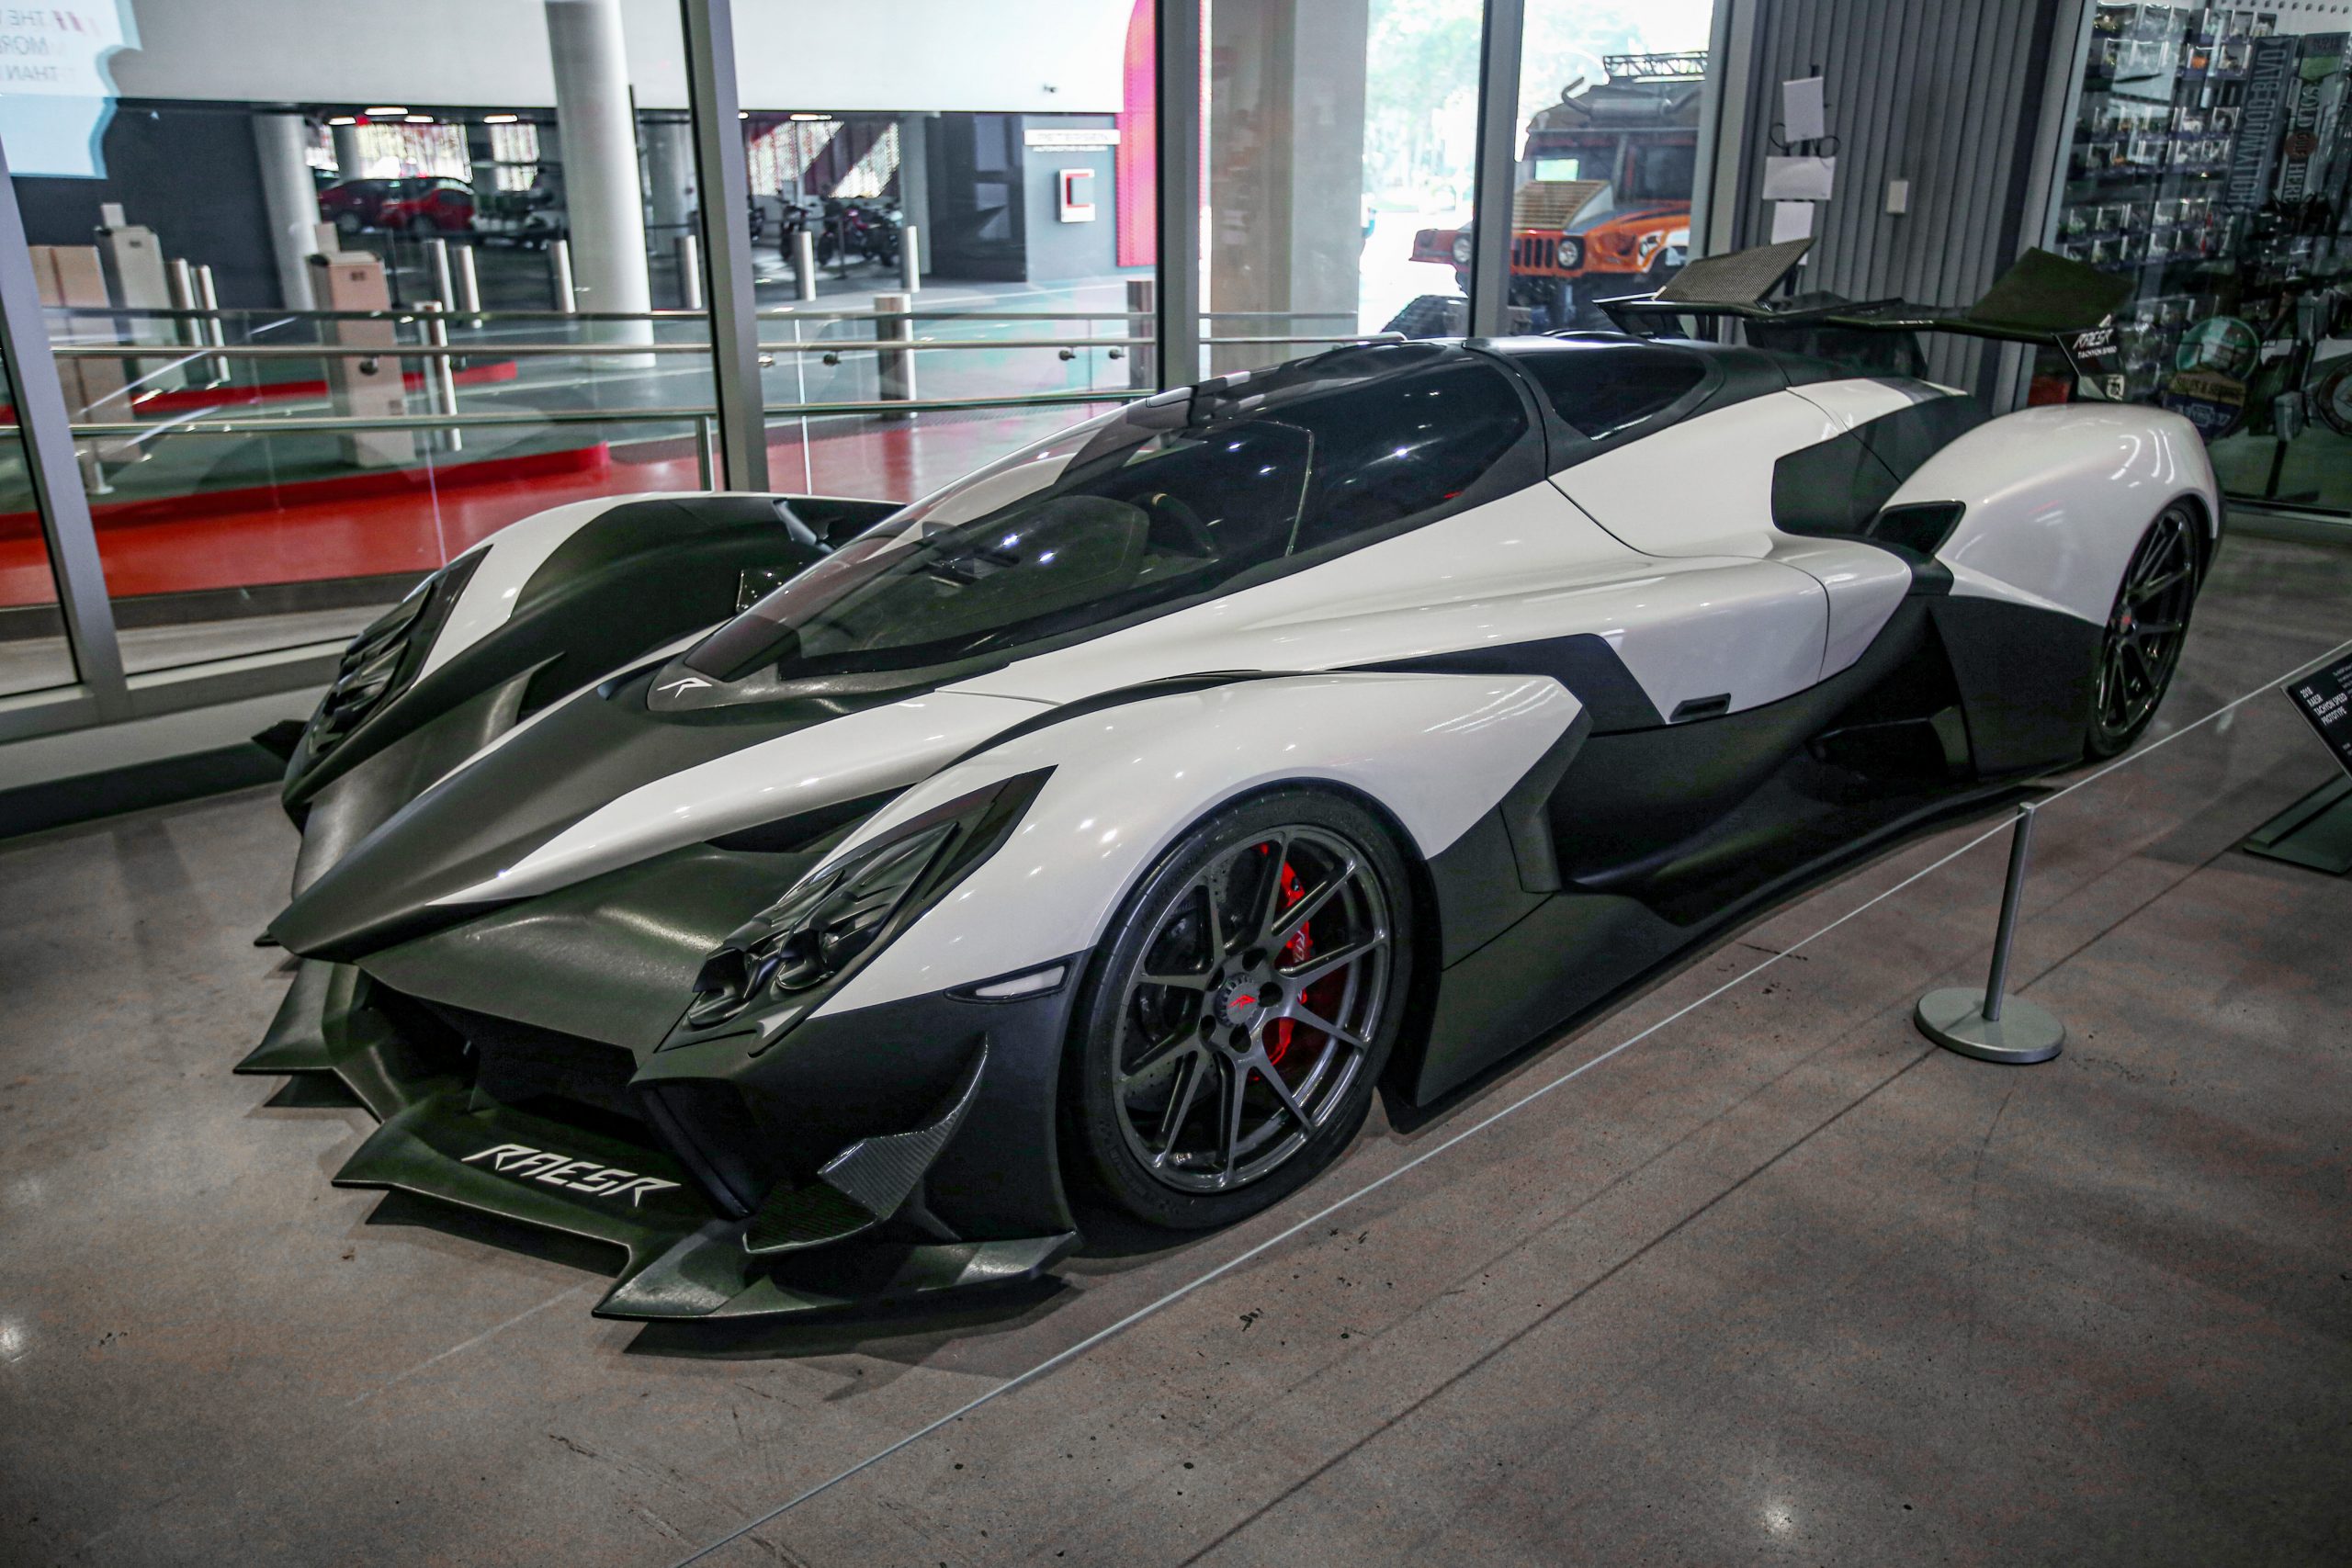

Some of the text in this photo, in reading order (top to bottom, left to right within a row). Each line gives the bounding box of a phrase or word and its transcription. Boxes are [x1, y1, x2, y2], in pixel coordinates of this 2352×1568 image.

[2227, 49, 2286, 204] HOLLYWOOD BLVD
[2298, 85, 2320, 128] SOLD
[2284, 163, 2306, 203] HERE
[2313, 693, 2347, 716] TACHYON SPEED
[2321, 705, 2347, 727] PROTOTYPE
[461, 1144, 682, 1208] RAESR
